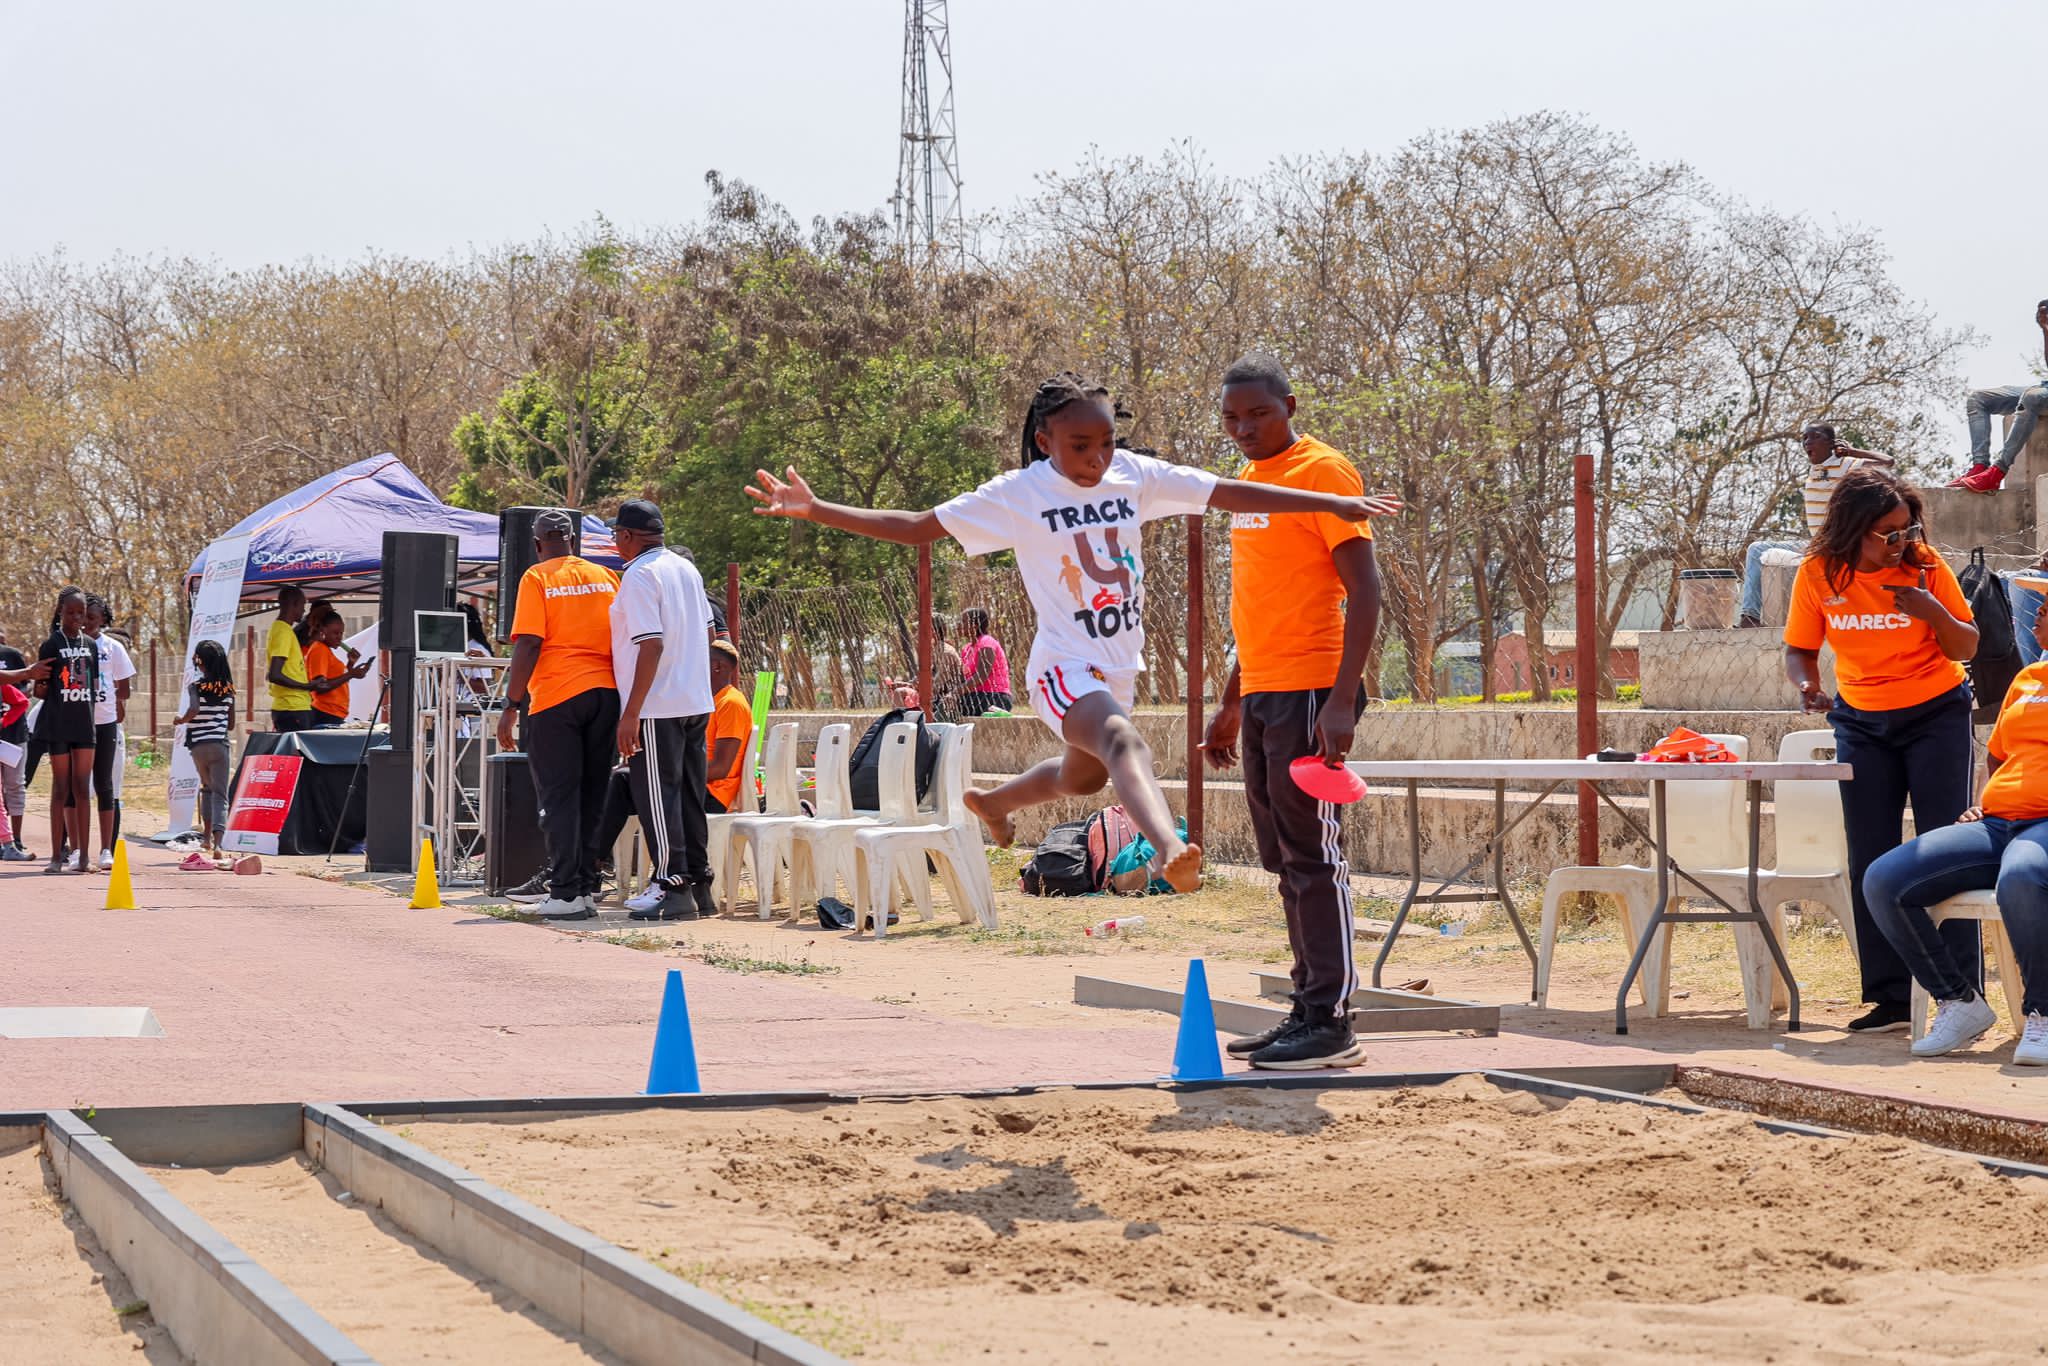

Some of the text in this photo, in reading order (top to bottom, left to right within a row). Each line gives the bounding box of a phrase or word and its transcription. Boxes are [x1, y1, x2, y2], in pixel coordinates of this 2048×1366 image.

[1041, 498, 1135, 532] TRACK
[261, 559, 336, 572] ADVENTURES
[545, 583, 615, 599] FACILIATOR
[1827, 613, 1912, 630] WARECS
[59, 647, 92, 658] TRACK
